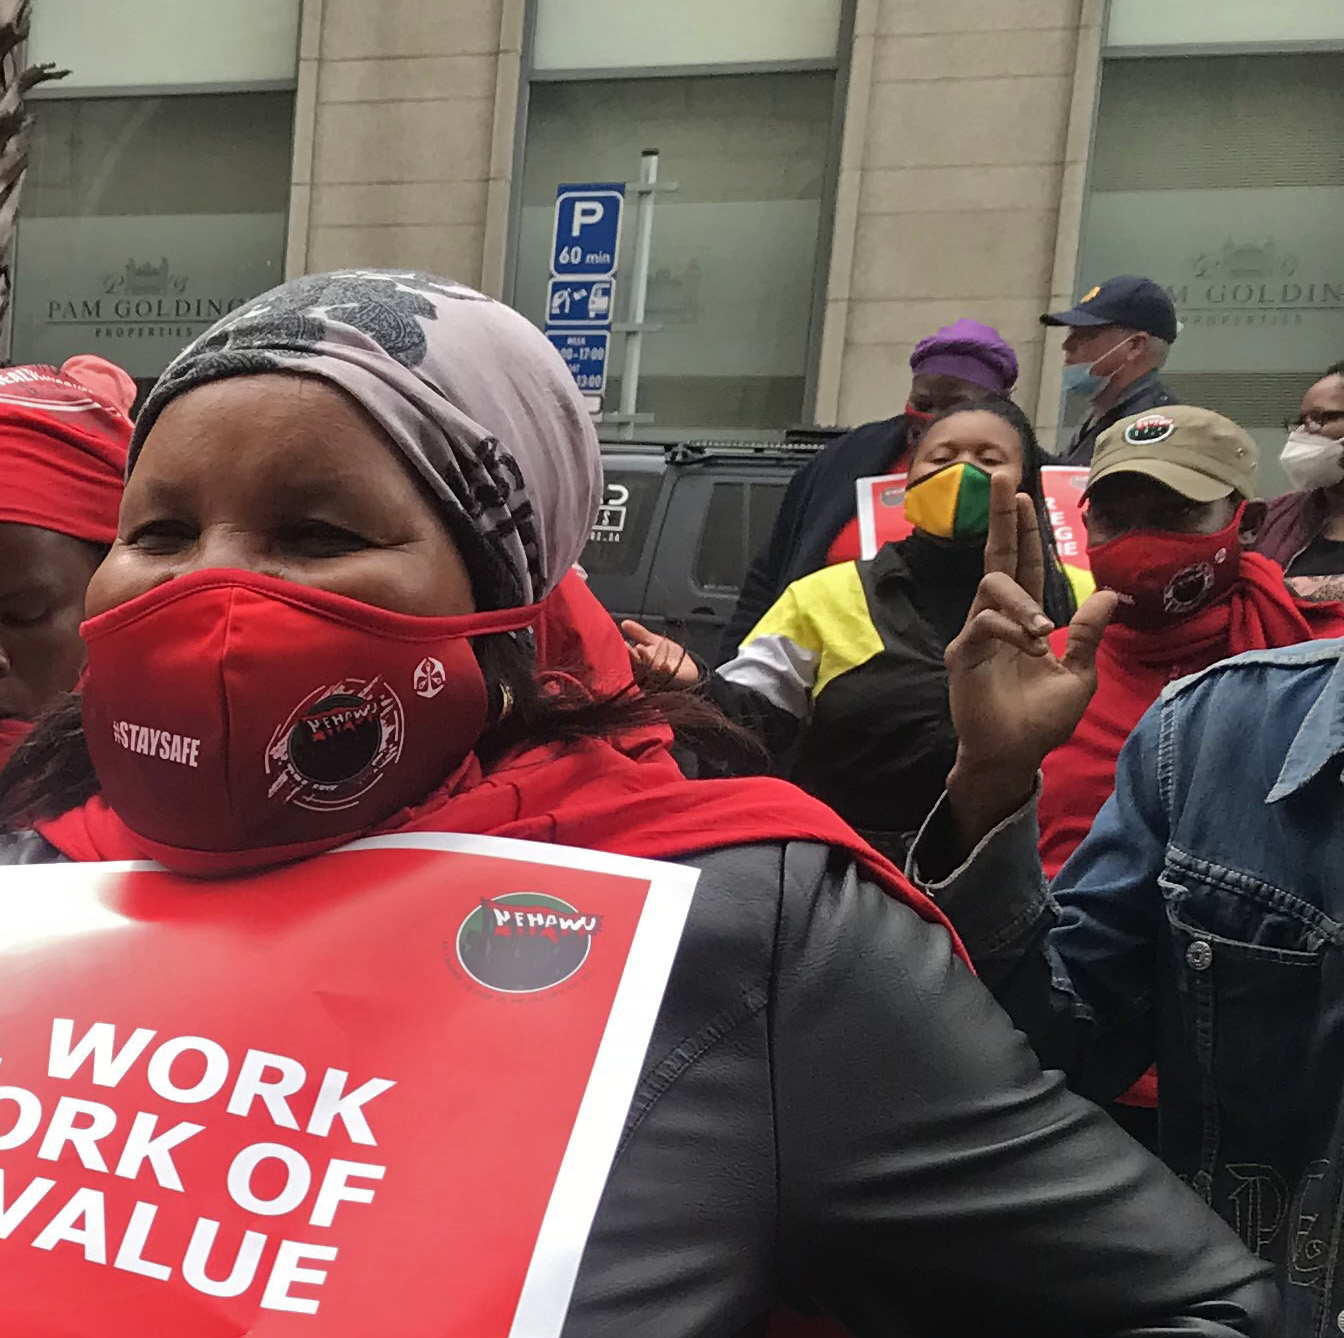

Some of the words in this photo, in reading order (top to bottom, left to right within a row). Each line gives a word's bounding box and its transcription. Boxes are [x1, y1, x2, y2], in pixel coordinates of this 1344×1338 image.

[572, 201, 604, 236] P
[559, 246, 582, 264] 60
[585, 251, 611, 264] min
[1206, 284, 1344, 303] GOLDIN
[48, 301, 101, 318] PAM
[95, 327, 192, 338] PROPERTIES
[112, 720, 200, 768] #STAYSAFE
[493, 908, 596, 931] NEHAWU
[48, 1018, 397, 1146] WORK
[226, 1143, 387, 1228] OF
